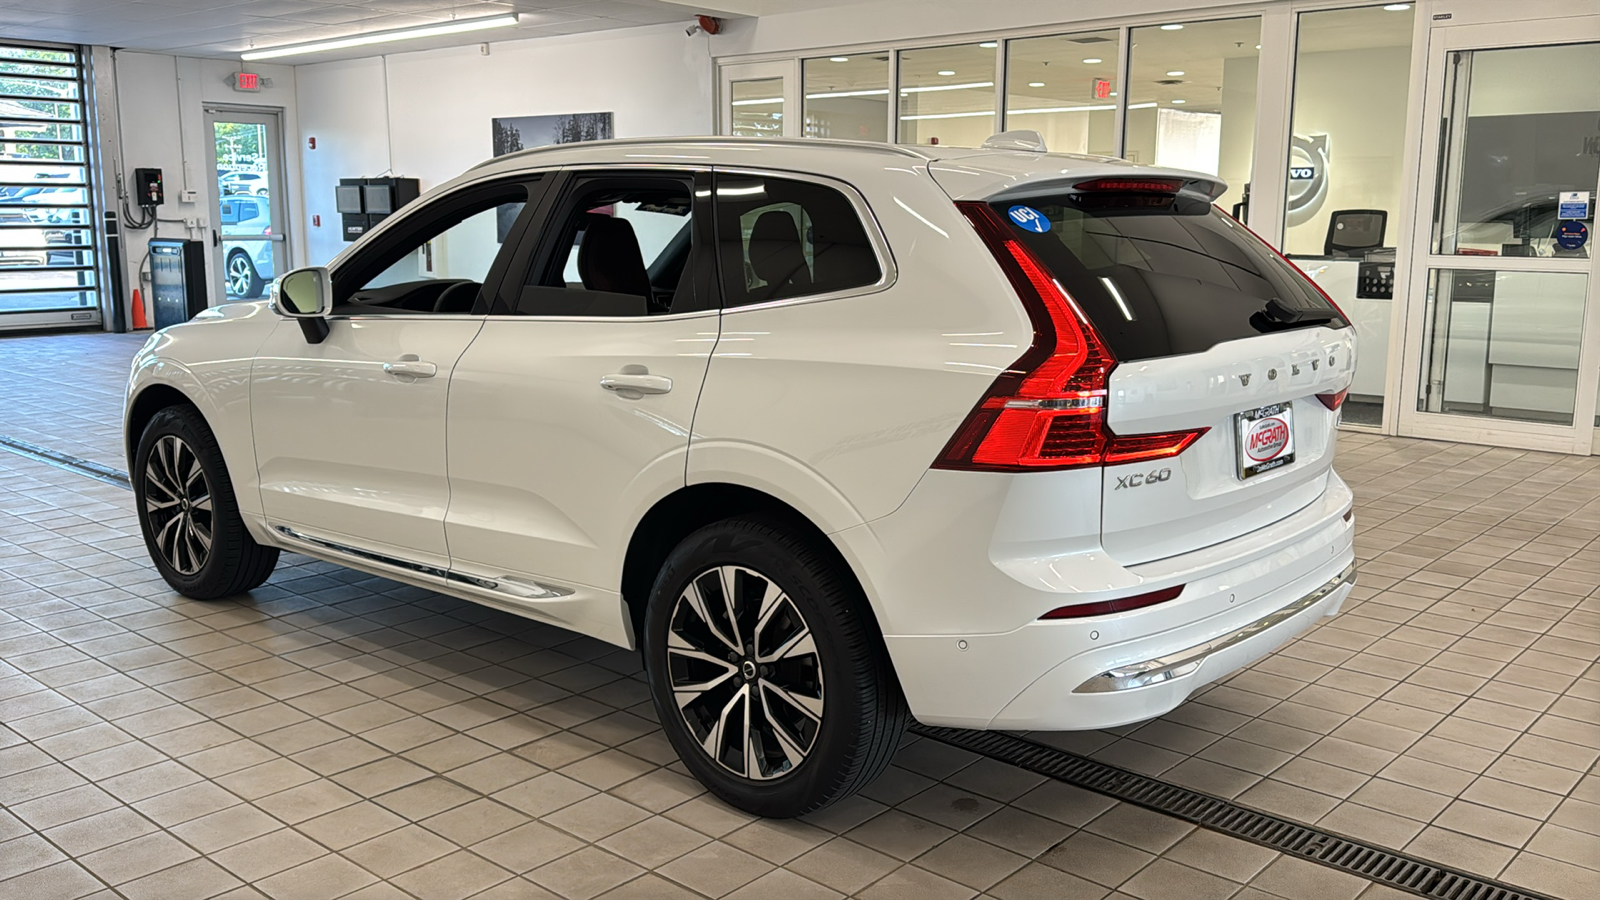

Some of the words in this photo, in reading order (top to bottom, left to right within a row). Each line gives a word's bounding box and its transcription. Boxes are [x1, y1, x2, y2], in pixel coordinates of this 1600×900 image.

[239, 73, 257, 89] EXIT
[1097, 81, 1110, 98] EXIT
[1239, 356, 1335, 387] VOLVO
[1114, 467, 1172, 490] XC60
